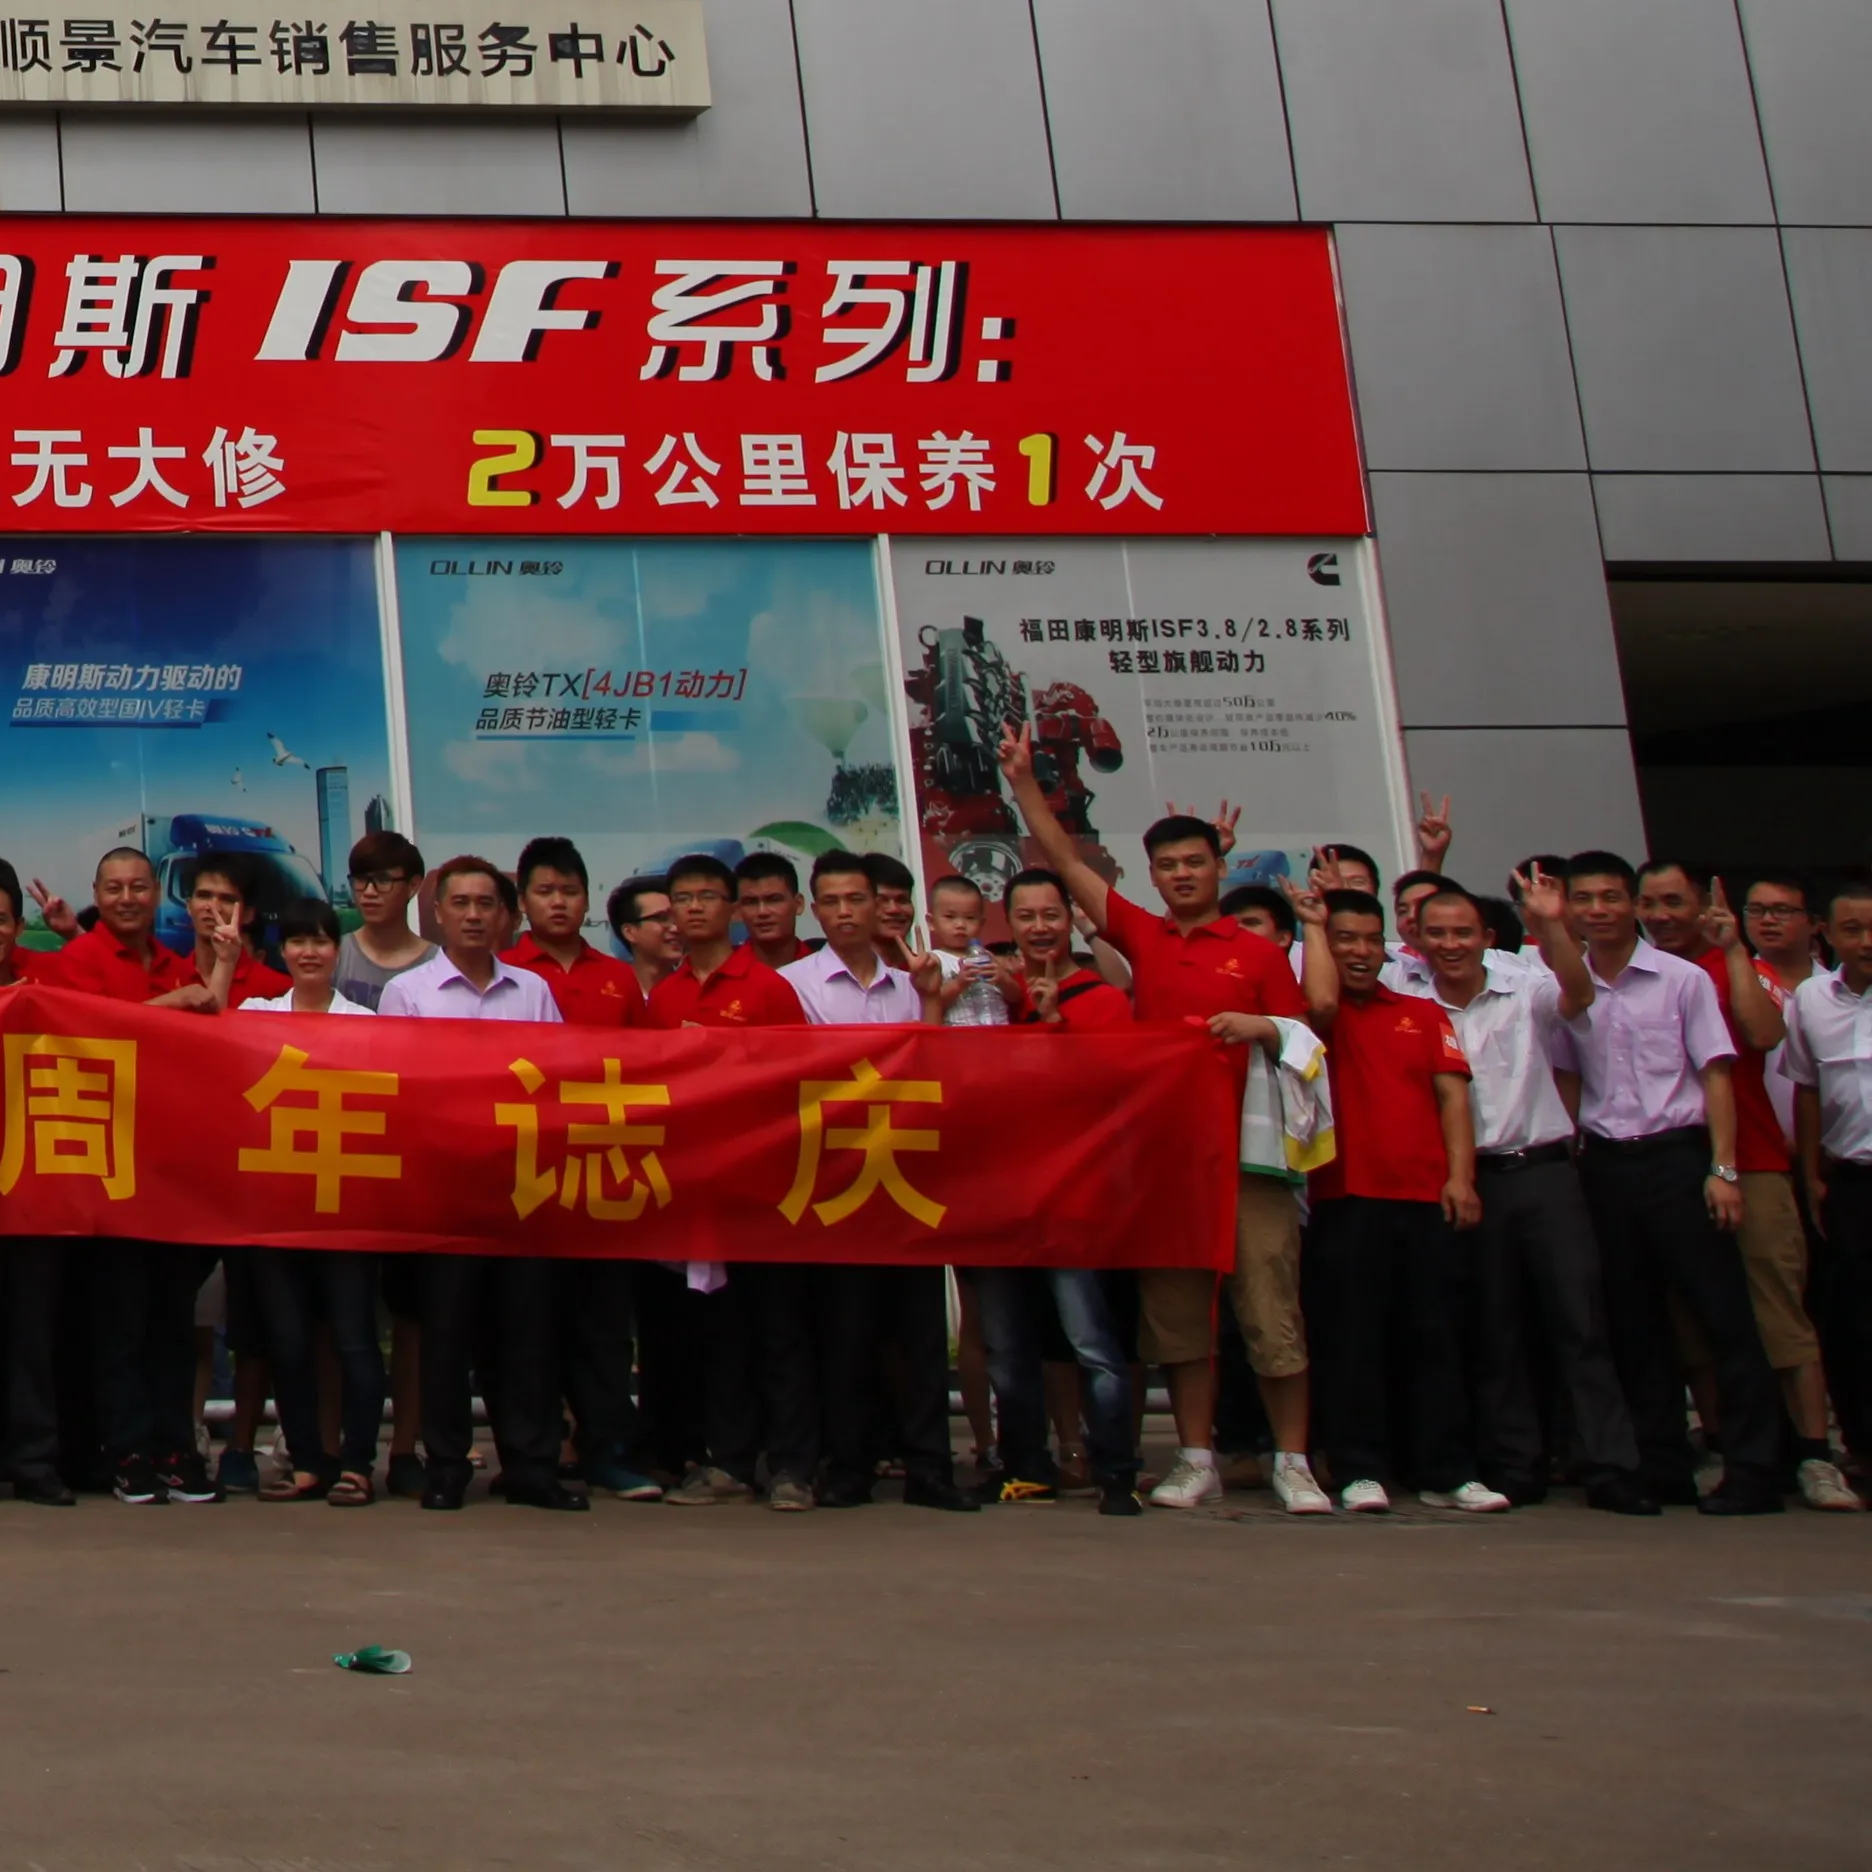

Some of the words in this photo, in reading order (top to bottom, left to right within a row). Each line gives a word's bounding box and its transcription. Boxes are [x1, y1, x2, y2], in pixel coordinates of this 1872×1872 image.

[256, 259, 615, 364] ISF
[468, 429, 1166, 512] 2万公里保养1次
[9, 558, 57, 575] 奥铃
[429, 560, 514, 576] OLLIN
[925, 560, 1006, 576] OLLIN
[1019, 616, 1352, 643] 福田康明斯ISF3.8/2.8系列
[1108, 648, 1266, 675] 轻型旗舰动力
[21, 662, 243, 692] 康明斯动力驱动的
[11, 697, 207, 721] 品质高效型国IV轻卡
[474, 707, 643, 732] 品质节油型轻卡
